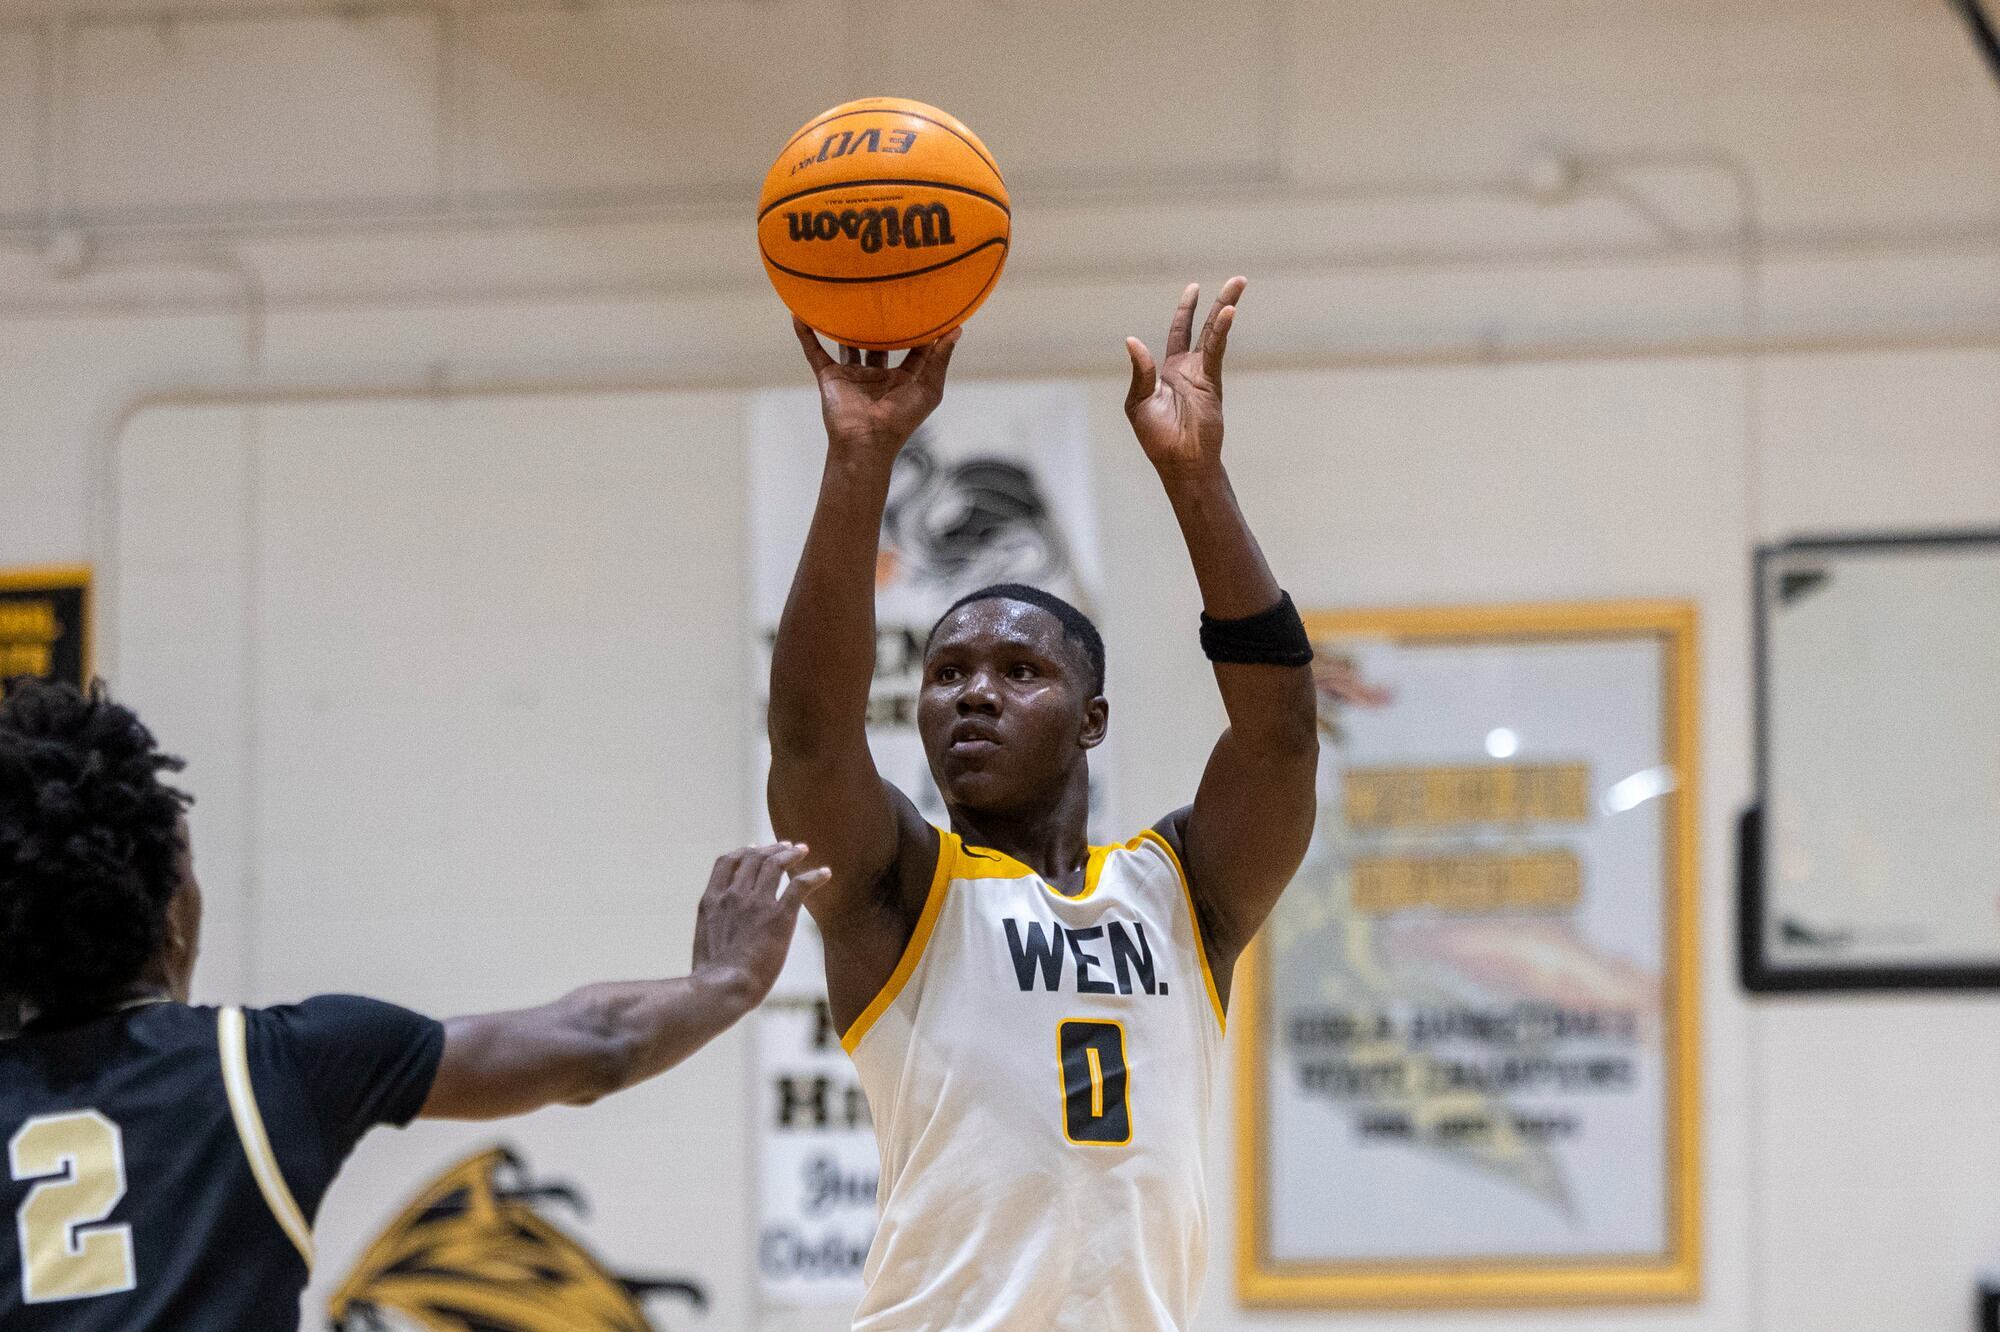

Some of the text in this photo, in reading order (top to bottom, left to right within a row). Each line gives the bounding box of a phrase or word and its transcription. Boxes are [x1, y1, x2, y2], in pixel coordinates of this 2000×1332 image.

[815, 128, 918, 163] EVO
[786, 202, 956, 254] Wilson
[1002, 917, 1169, 996] WEN.
[1057, 1017, 1132, 1147] 0
[8, 1108, 137, 1305] 2
